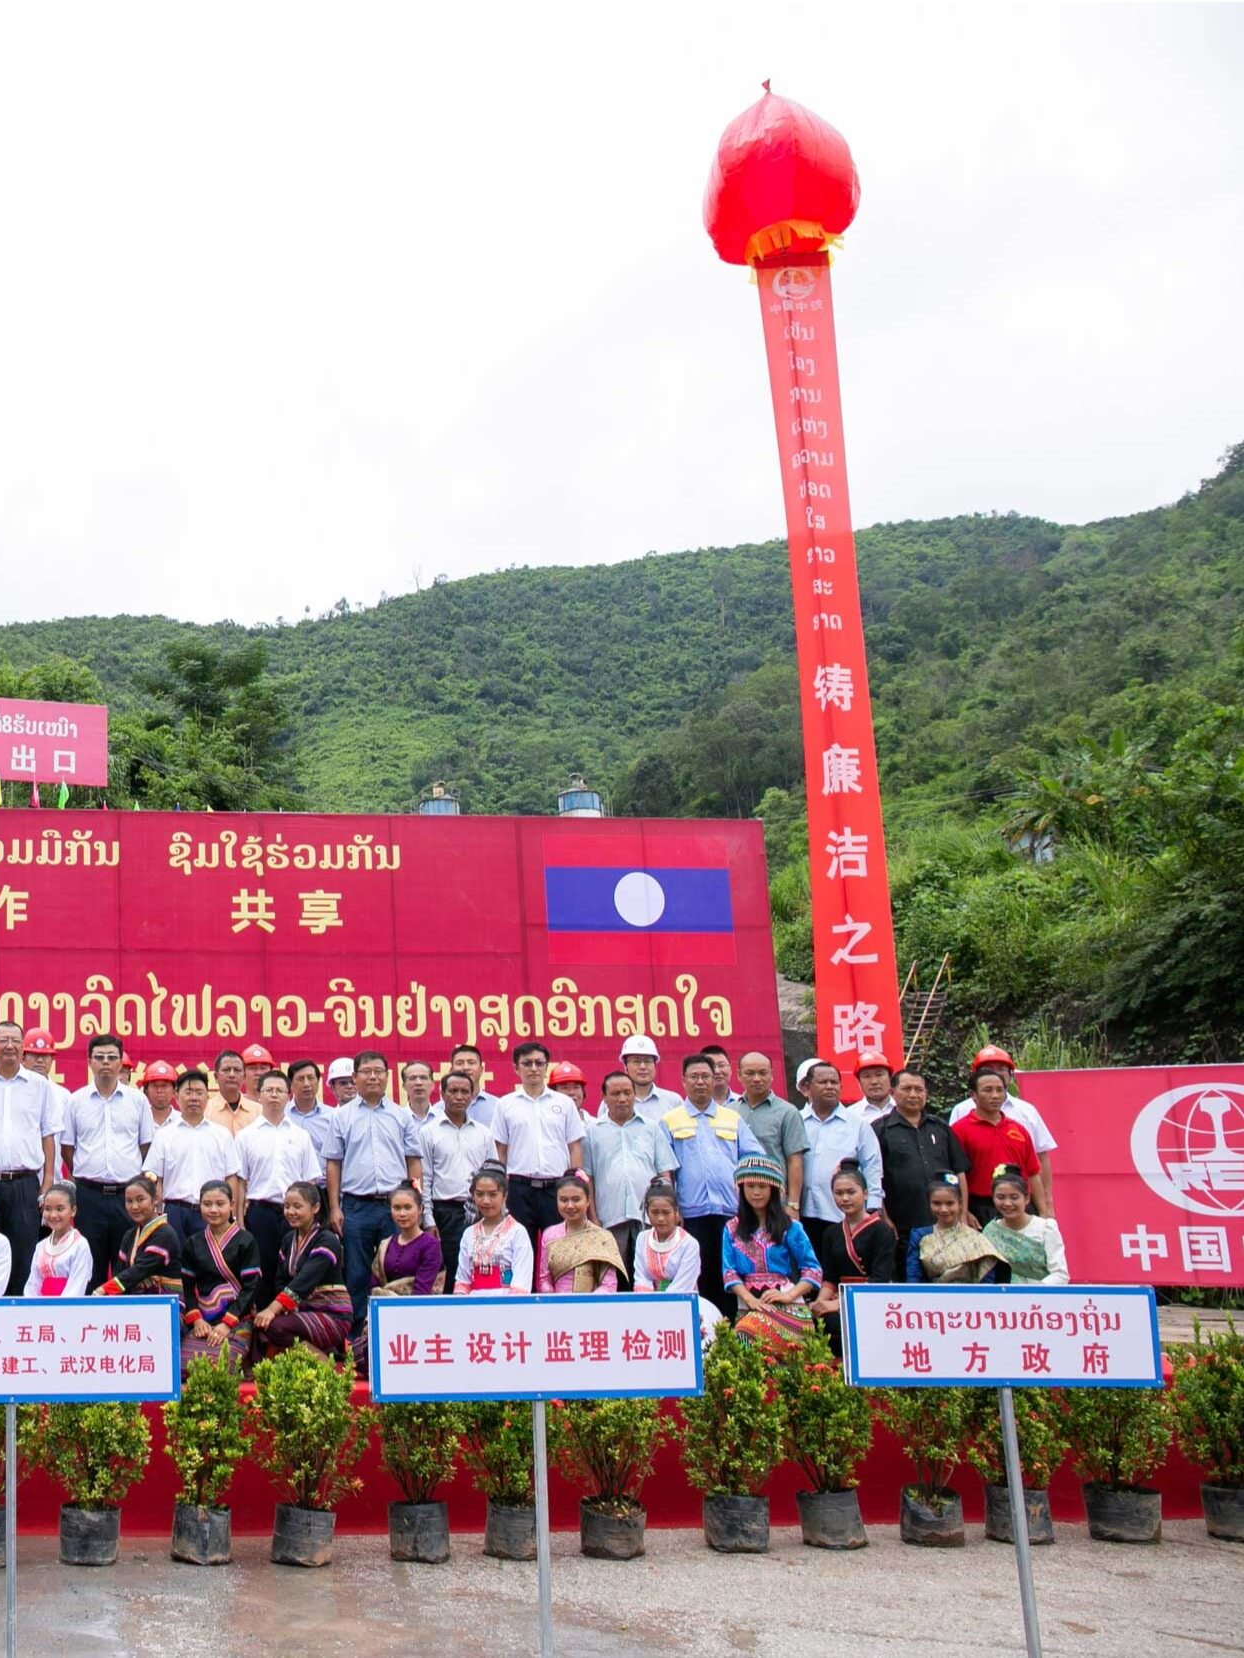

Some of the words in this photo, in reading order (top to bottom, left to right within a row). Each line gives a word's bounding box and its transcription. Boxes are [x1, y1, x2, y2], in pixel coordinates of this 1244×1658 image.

[812, 662, 886, 1056] 铸廉洁之路
[230, 888, 344, 935] 共享
[1120, 1223, 1244, 1274] 中国
[902, 1342, 1110, 1375] 地方政府
